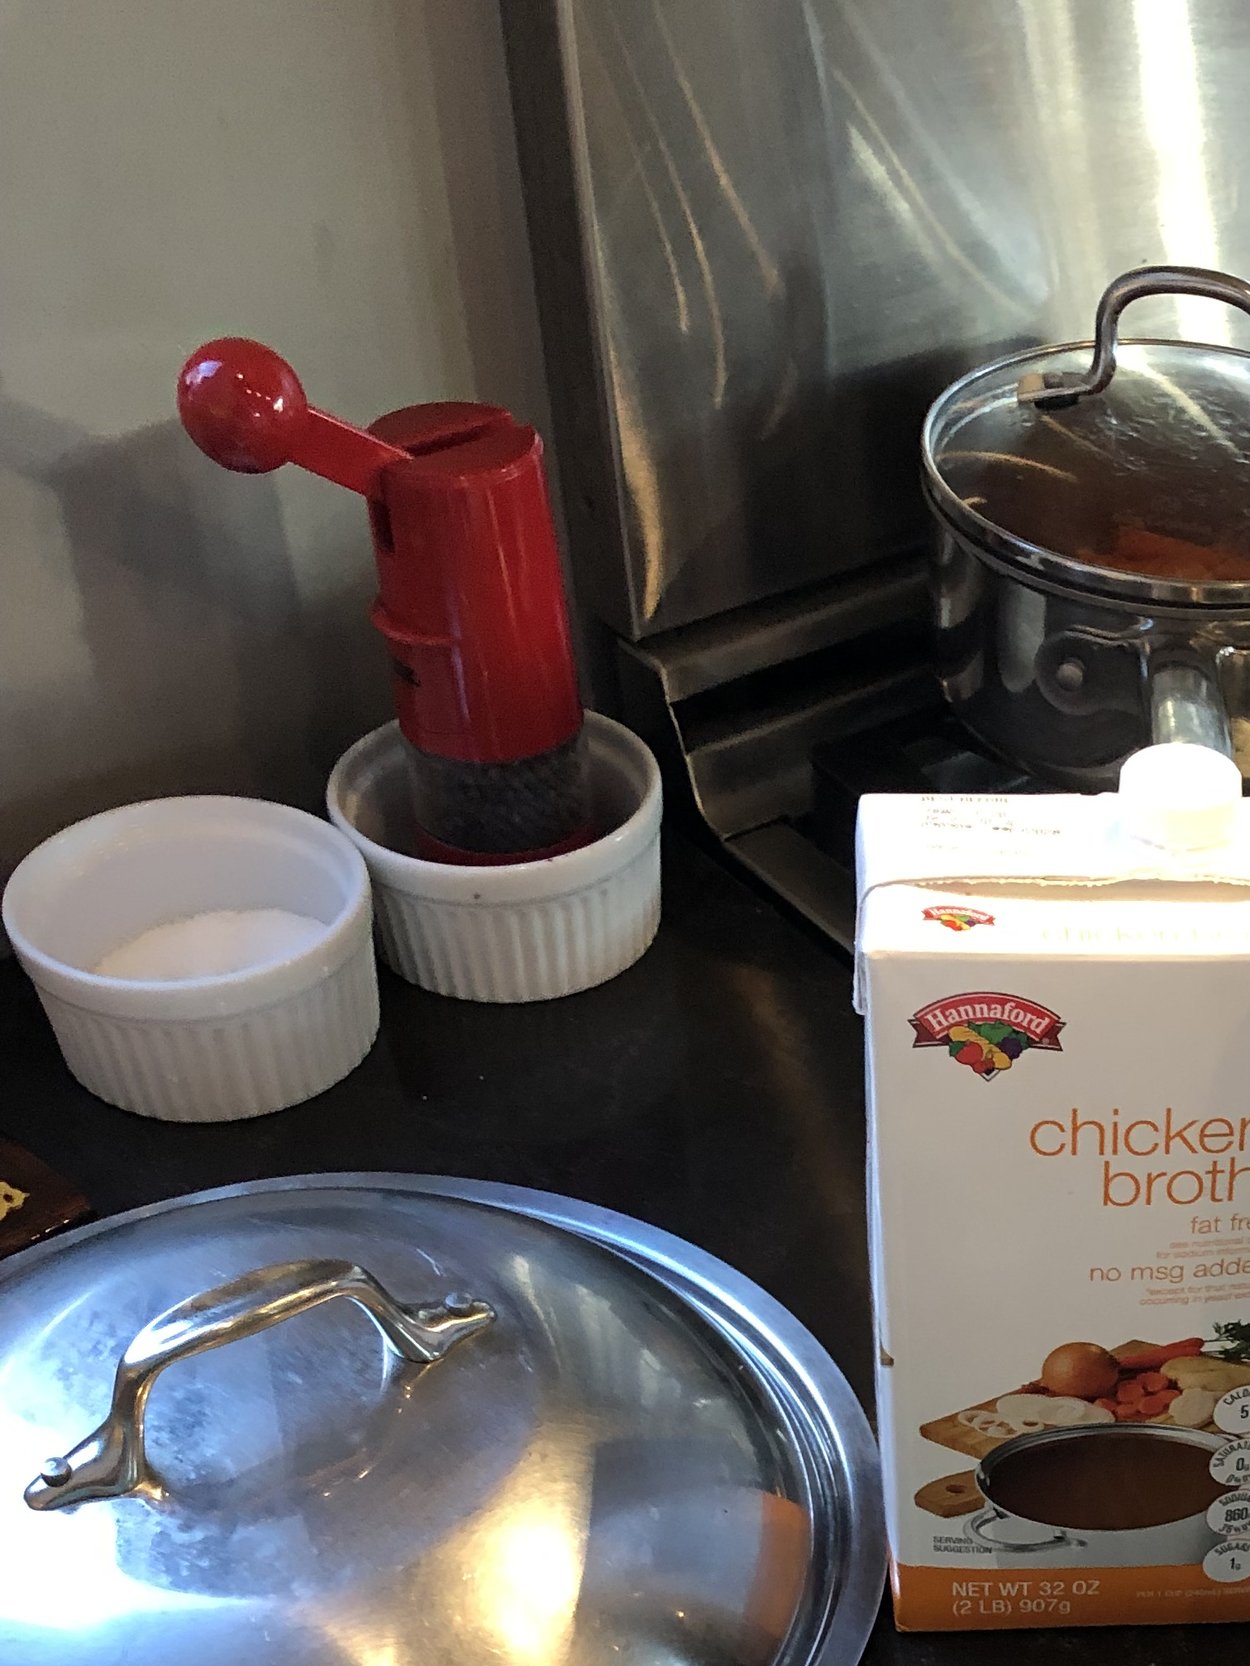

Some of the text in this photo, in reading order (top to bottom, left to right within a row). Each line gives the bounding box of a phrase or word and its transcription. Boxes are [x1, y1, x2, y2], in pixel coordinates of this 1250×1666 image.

[925, 1000, 1051, 1035] Hannaford
[1190, 1215, 1221, 1235] fat
[1089, 1267, 1121, 1282] no
[1131, 1264, 1185, 1284] msg
[1239, 1404, 1249, 1419] 5
[952, 1580, 1100, 1597] NET WT 32 OZ
[952, 1598, 1071, 1616] (2 LB) 907g
